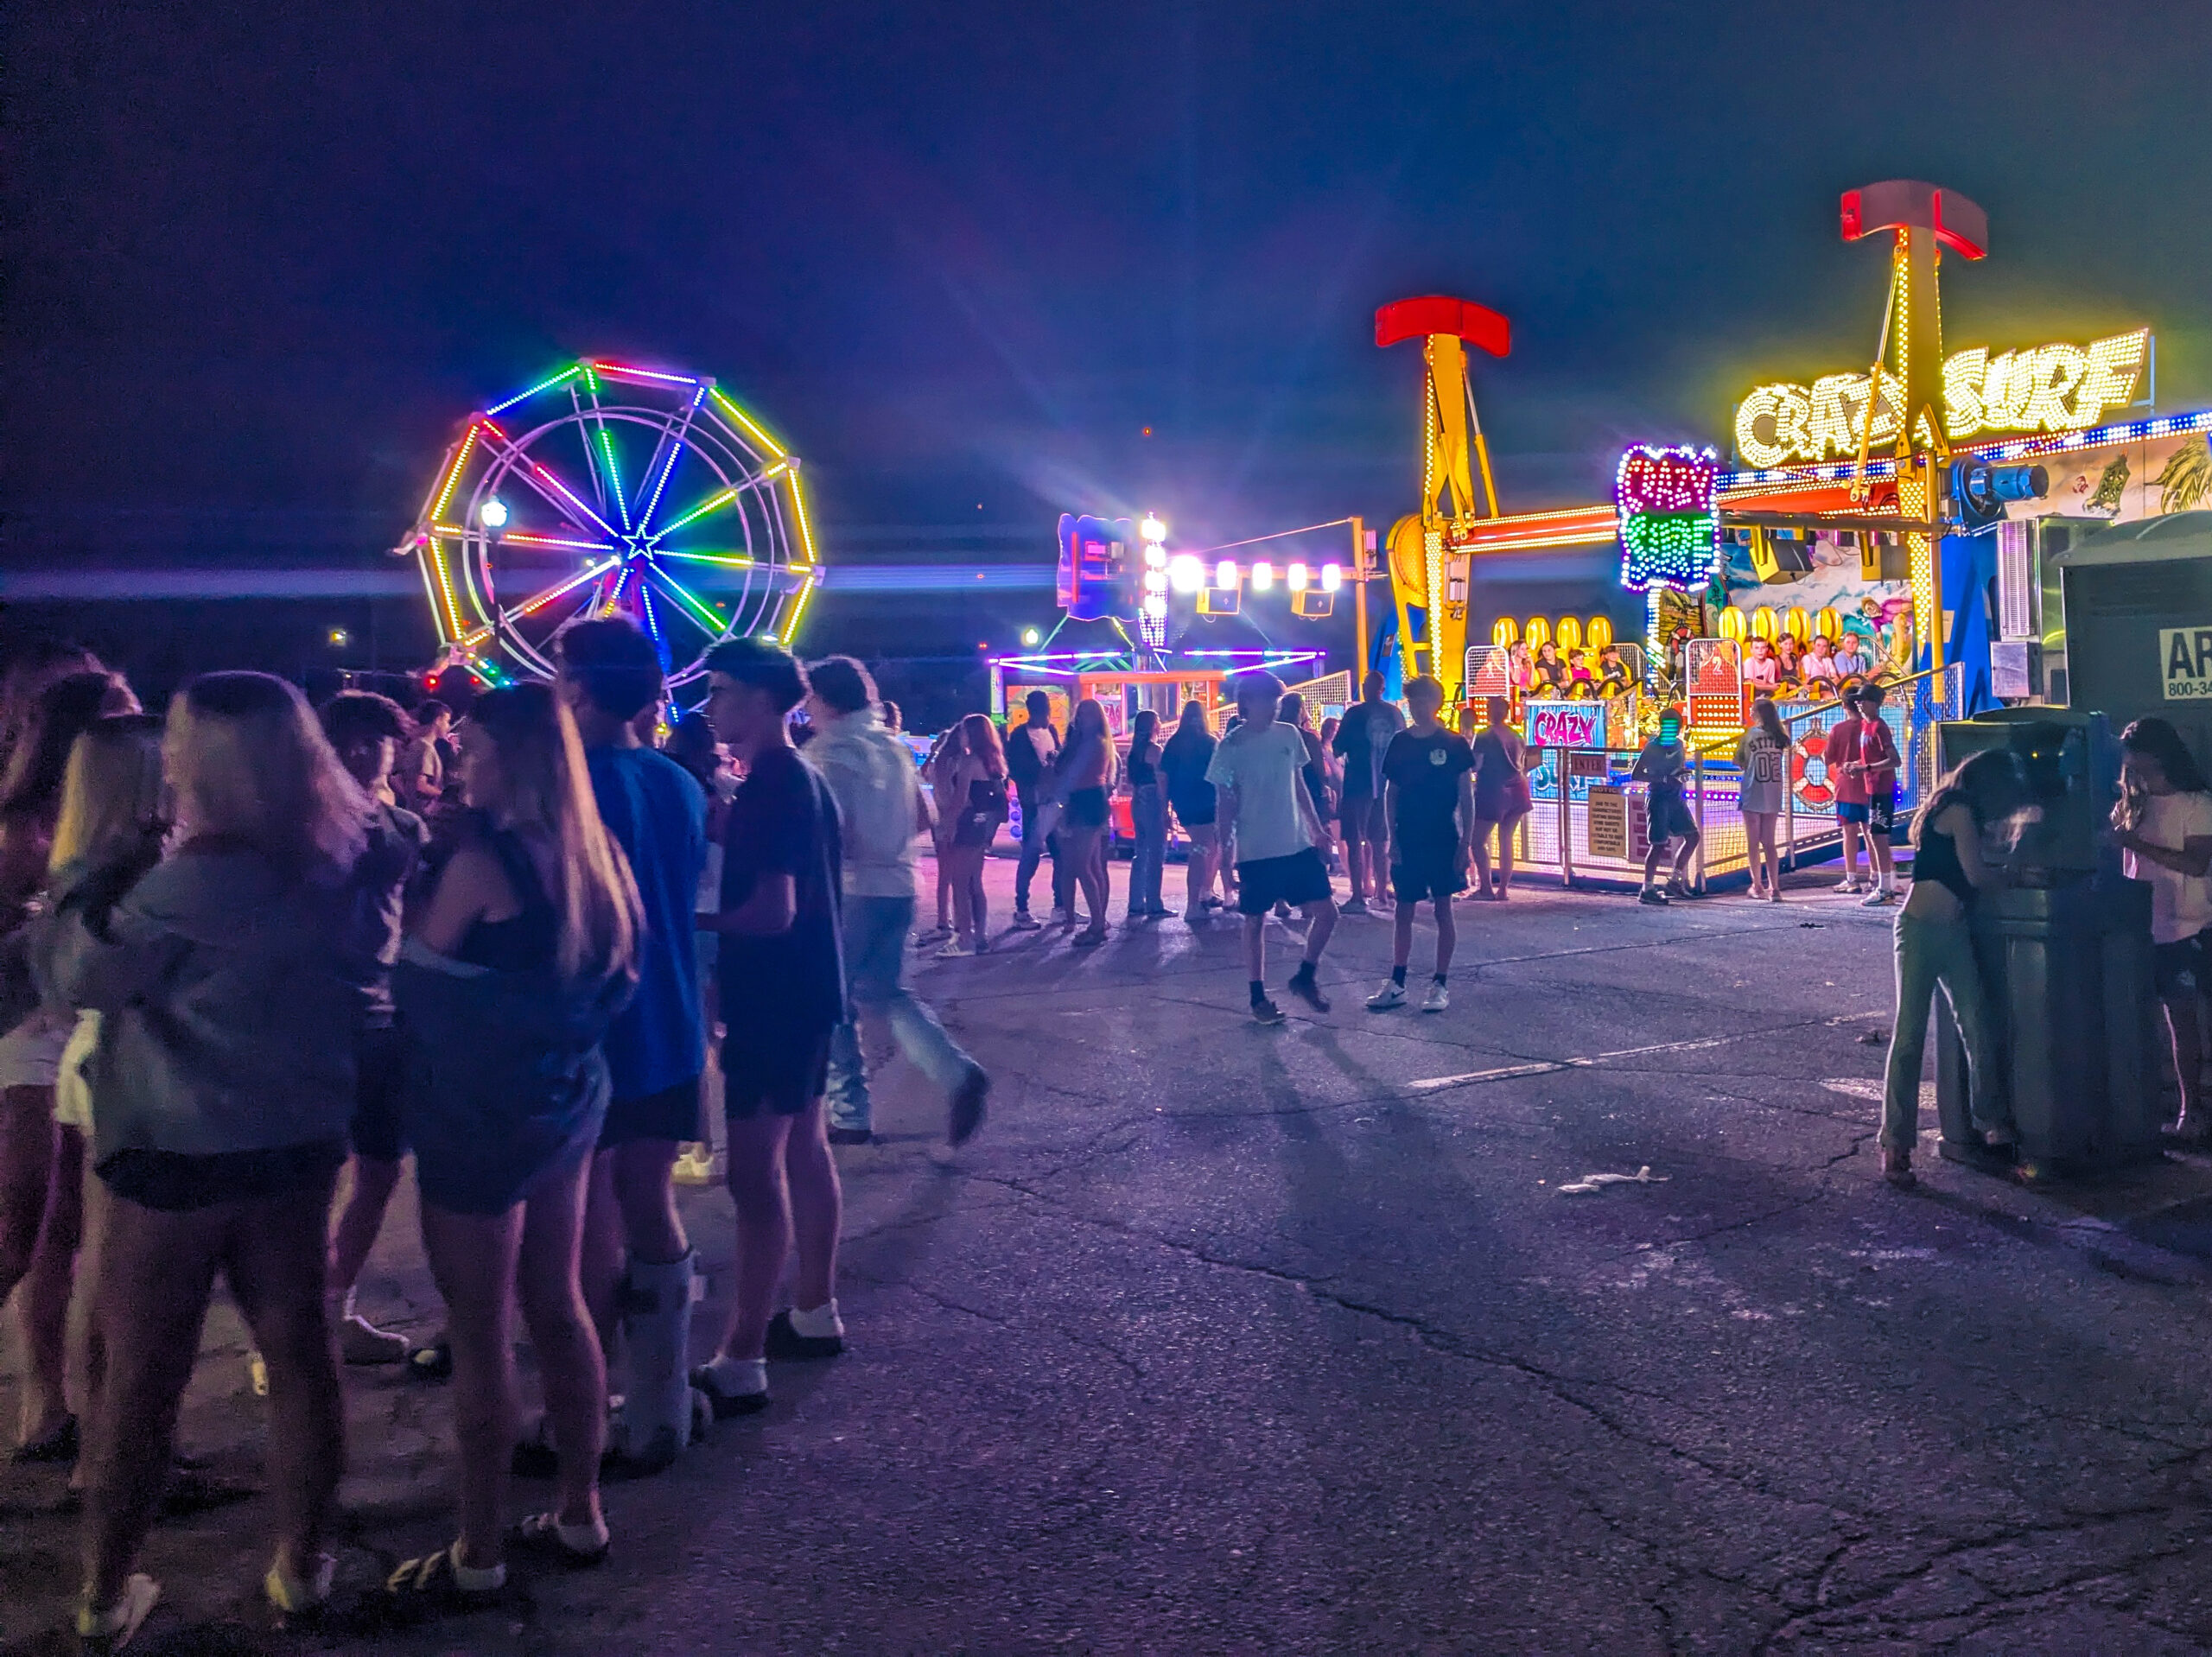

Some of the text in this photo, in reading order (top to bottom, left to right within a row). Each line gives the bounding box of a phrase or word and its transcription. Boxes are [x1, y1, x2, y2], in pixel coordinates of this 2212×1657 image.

[1736, 329, 2147, 468] CRAZ SURF
[1626, 459, 1710, 512] CRAZY
[1627, 515, 1713, 581] SURF
[1712, 656, 1724, 676] 2
[1534, 710, 1597, 747] CRAZY
[1573, 757, 1603, 771] ENTER
